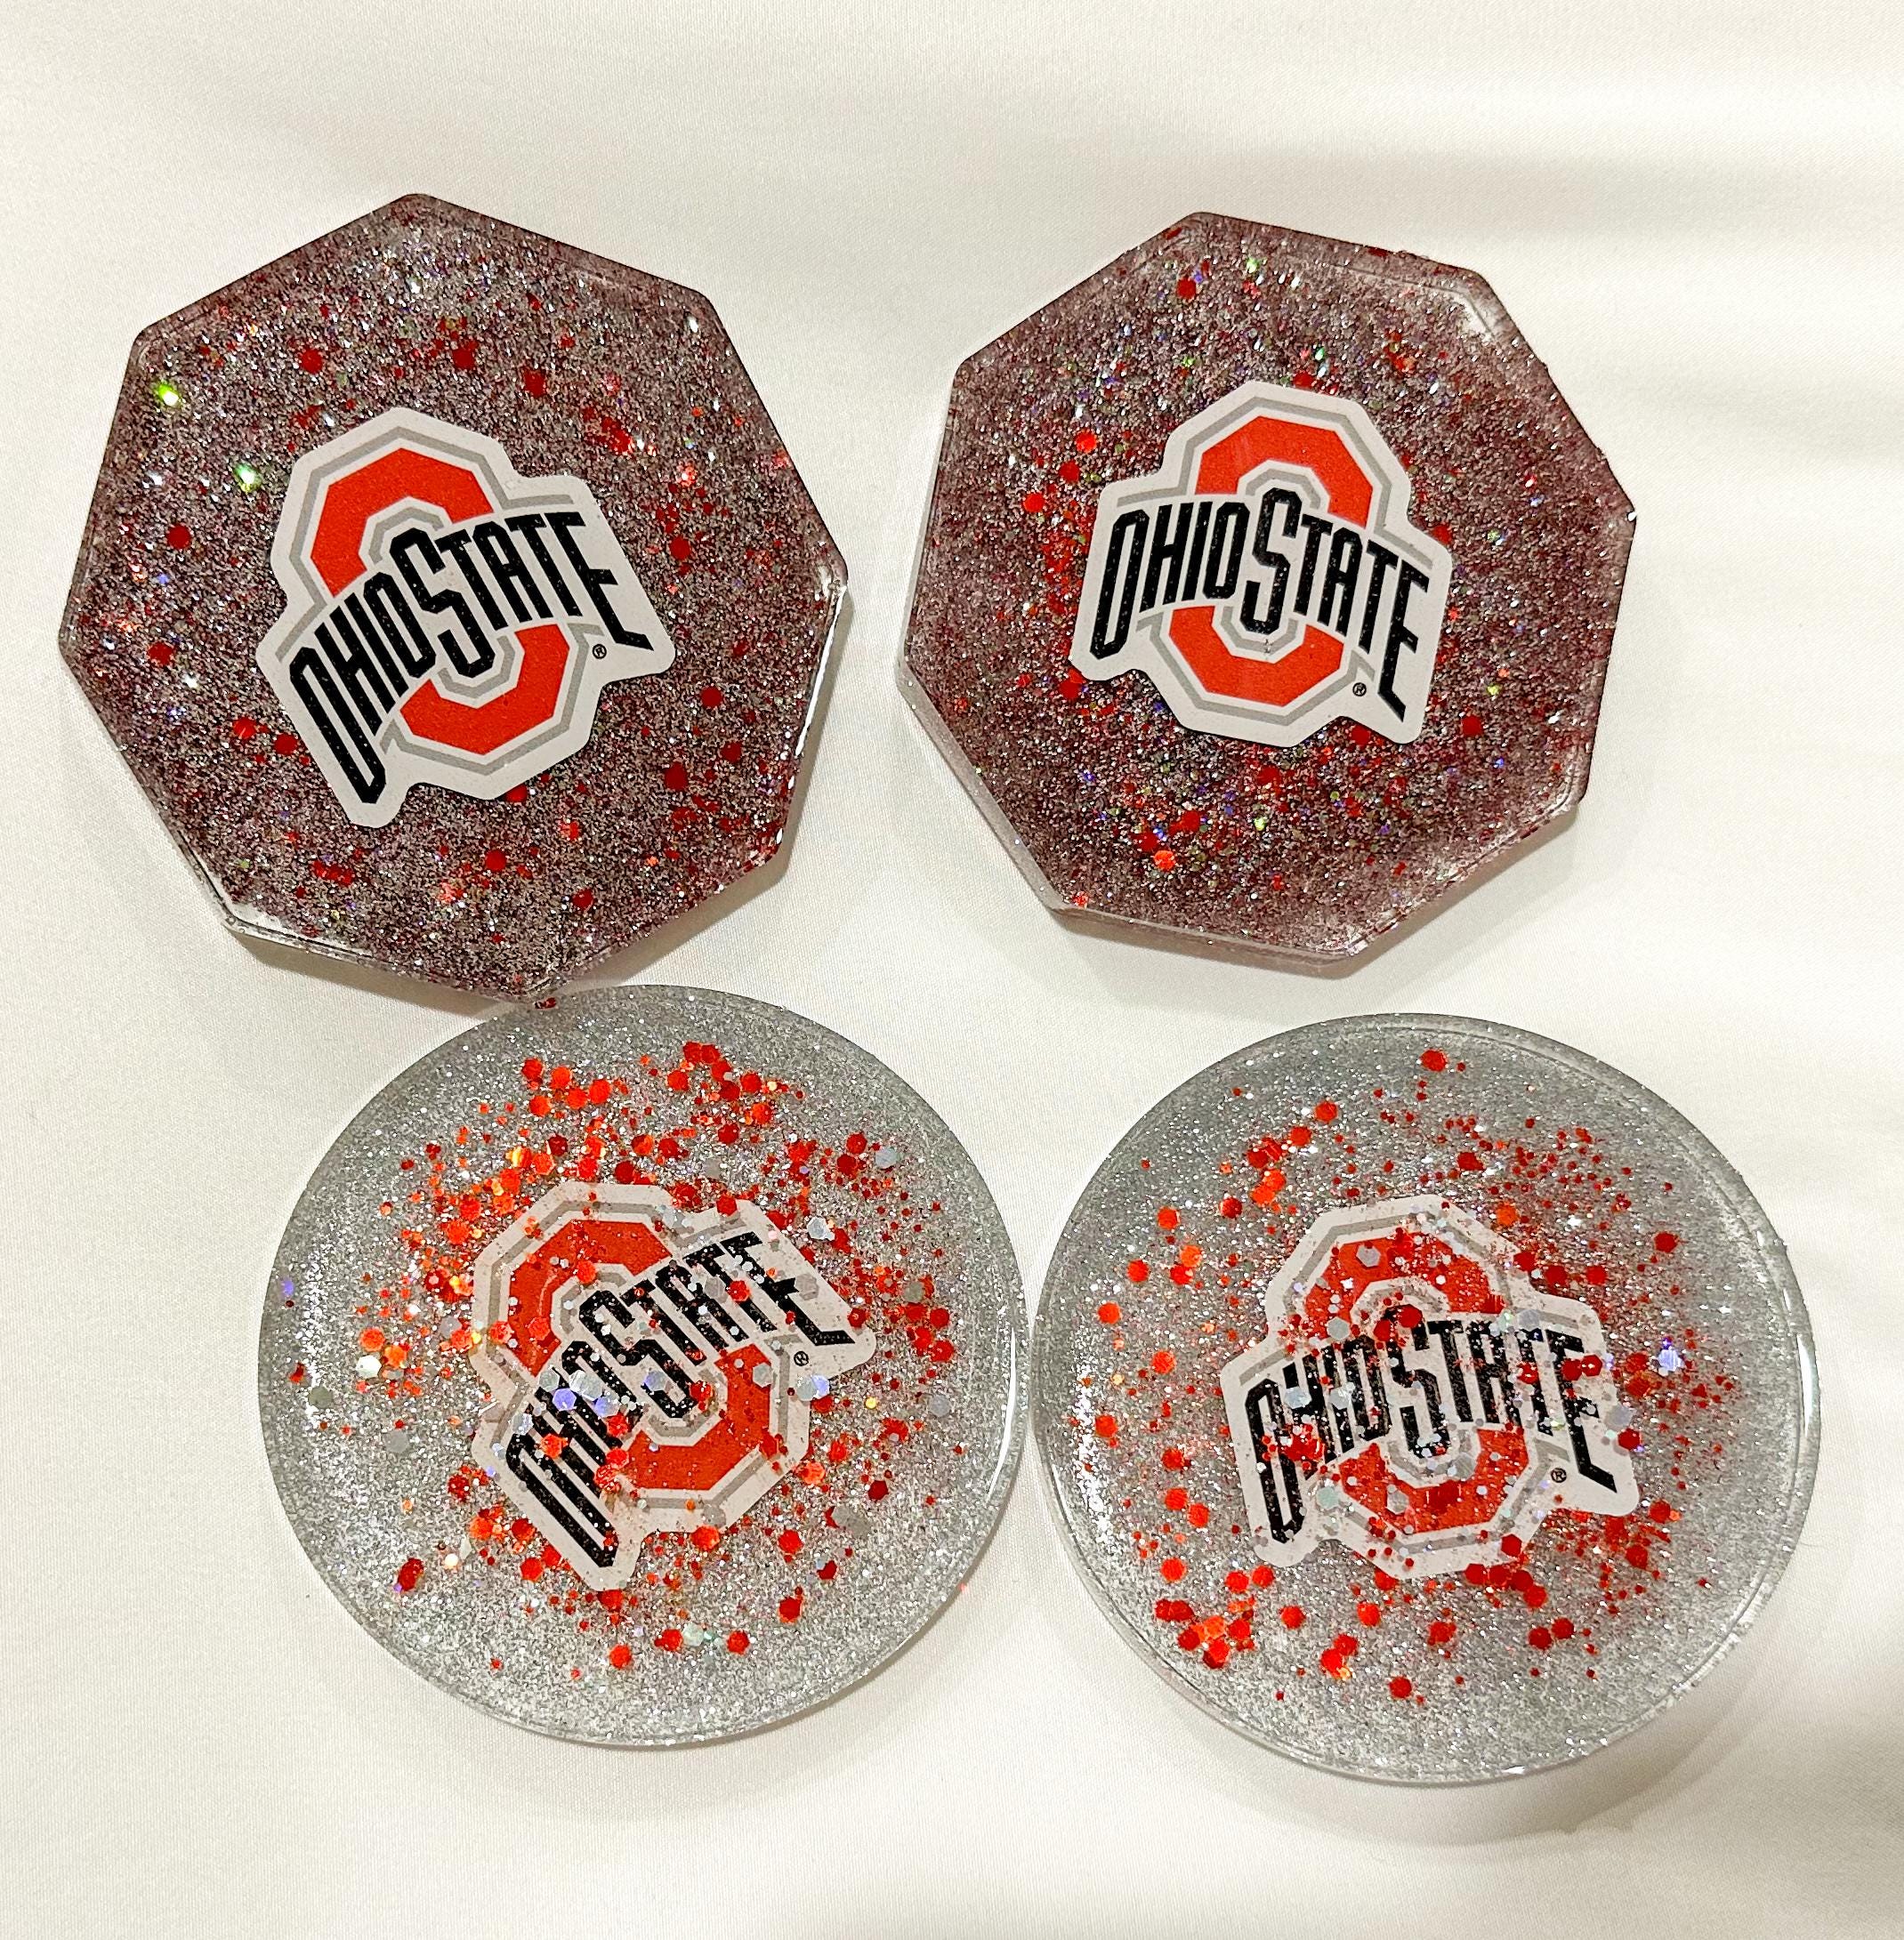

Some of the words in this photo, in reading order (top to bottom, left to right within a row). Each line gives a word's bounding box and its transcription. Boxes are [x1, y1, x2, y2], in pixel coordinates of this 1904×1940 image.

[289, 572, 436, 804] OHIO
[390, 511, 654, 679] STATE
[1089, 501, 1250, 660] OHIO
[1239, 487, 1430, 722] STATE
[505, 1340, 644, 1567] OHIO
[578, 1231, 855, 1419] STATE
[1246, 1335, 1391, 1543] OHIO
[1383, 1304, 1618, 1493] STATE
